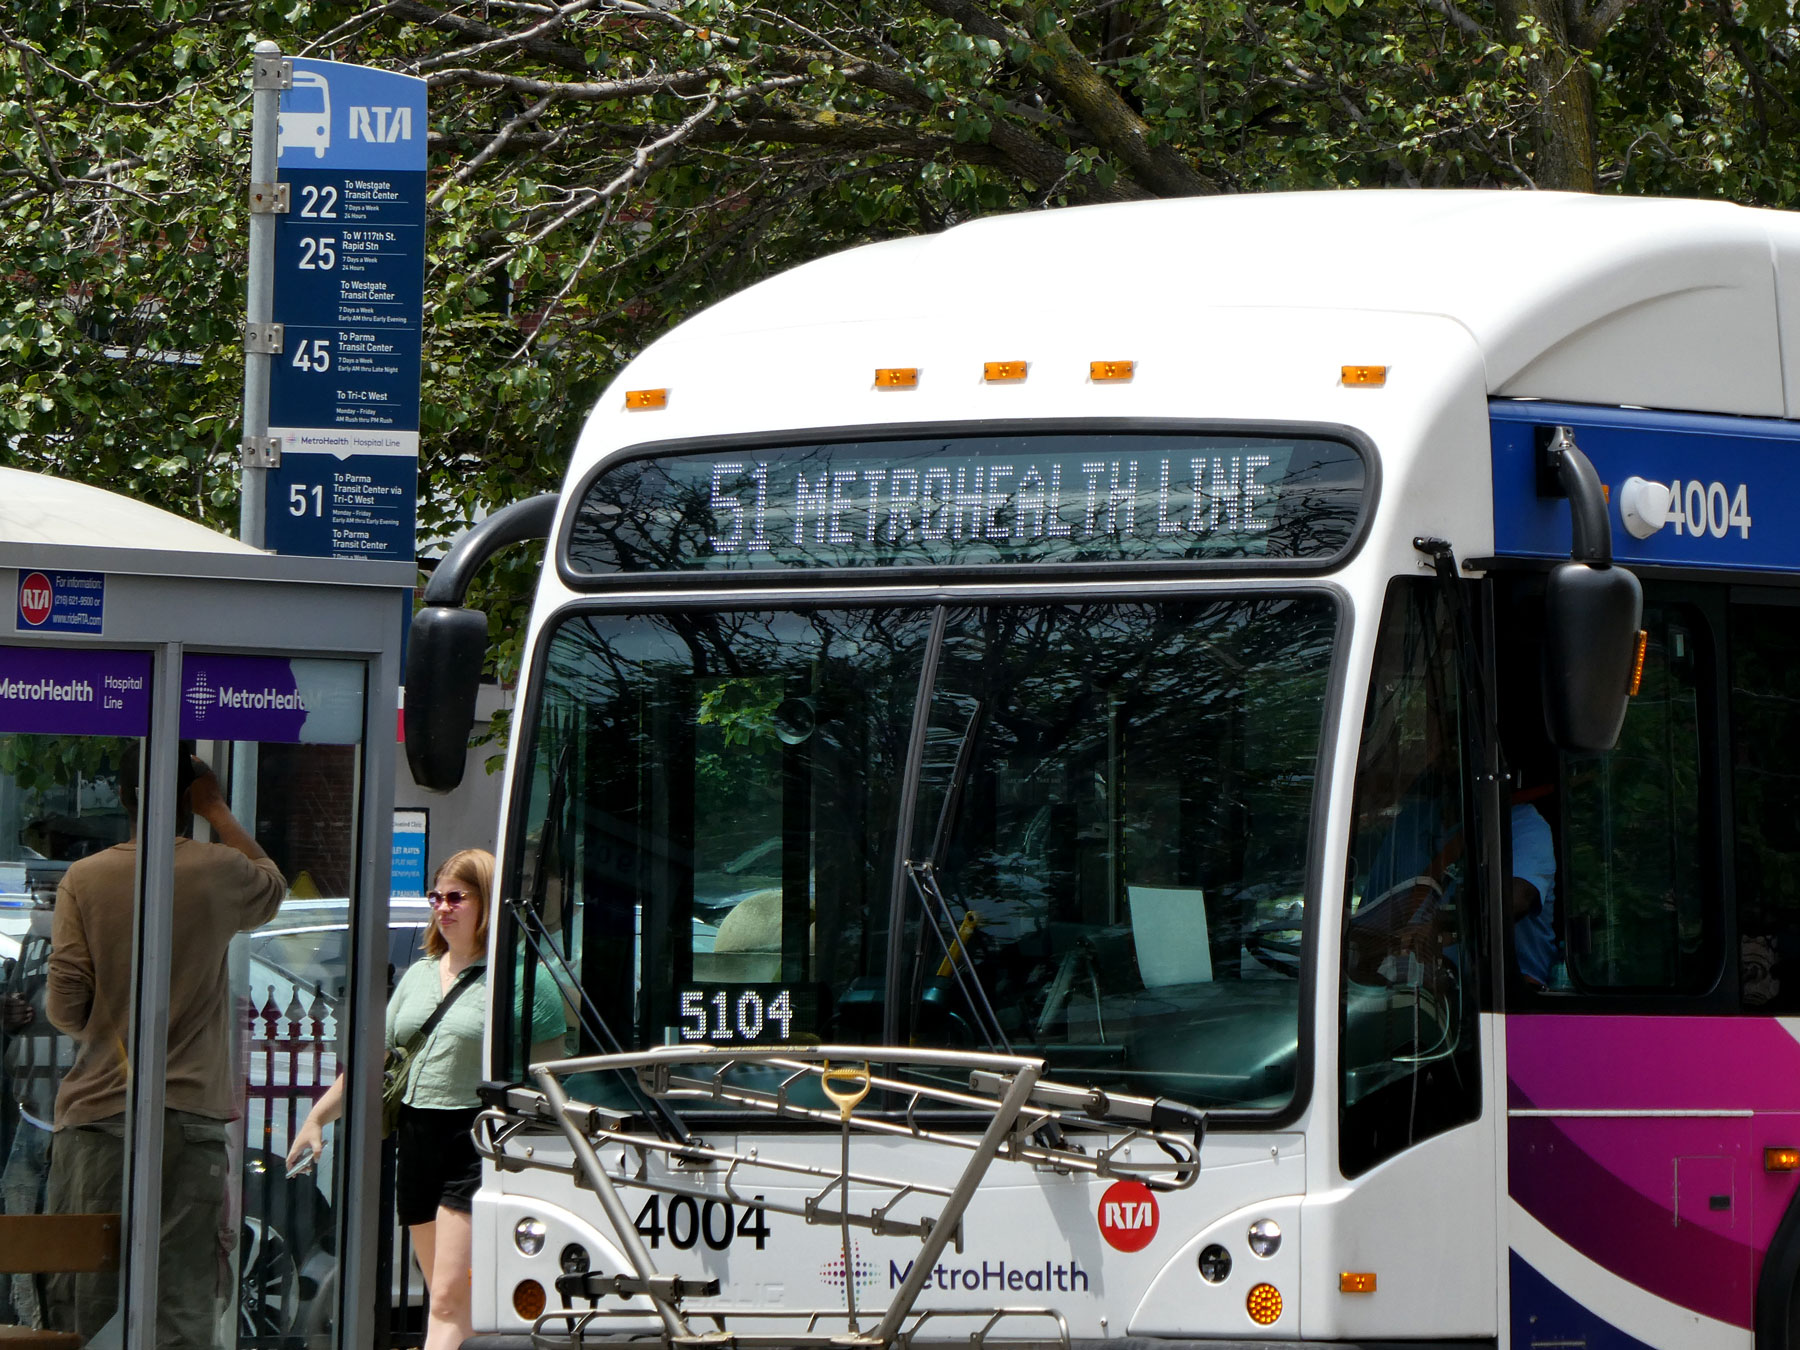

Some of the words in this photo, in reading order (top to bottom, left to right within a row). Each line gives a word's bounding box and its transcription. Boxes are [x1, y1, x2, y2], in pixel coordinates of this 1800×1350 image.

[349, 106, 412, 143] RTA
[344, 180, 354, 189] To
[355, 180, 391, 192] Westgate
[344, 190, 372, 199] Transit
[372, 191, 399, 200] Center
[300, 185, 338, 219] 22
[349, 204, 361, 212] Days
[343, 231, 352, 240] To
[353, 231, 363, 240] W
[363, 232, 385, 241] 117th
[385, 232, 397, 241] St.
[342, 241, 365, 251] Rapid
[365, 242, 379, 251] Stn
[298, 237, 336, 271] 25
[347, 256, 360, 264] Days
[341, 281, 350, 290] To
[351, 281, 387, 292] Westgate
[340, 290, 367, 300] Transit
[368, 291, 395, 301] Center
[386, 316, 407, 324] Evening
[338, 332, 348, 341] To
[349, 332, 375, 342] Parma
[338, 342, 366, 351] Transit
[367, 343, 394, 352] Center
[292, 339, 330, 373] 45
[342, 357, 354, 365] Days
[336, 390, 346, 400] To
[347, 391, 367, 400] Tri-C
[368, 391, 388, 401] West
[359, 408, 376, 416] Friday
[301, 436, 349, 447] MetroHealth
[353, 437, 384, 448] Hospital
[385, 439, 401, 448] Line
[334, 473, 344, 482] To
[345, 473, 371, 483] Parma
[333, 483, 362, 494] Transit
[363, 484, 389, 495] Center
[390, 485, 402, 495] via
[289, 483, 323, 518] 51
[333, 494, 353, 504] Tri-C
[354, 495, 375, 505] West
[709, 463, 771, 551] 51
[794, 460, 1138, 544] METROHEALTH
[1157, 455, 1270, 532] LINE
[332, 509, 352, 517] Monday
[355, 510, 371, 518] Friday
[1664, 480, 1752, 539] 4004
[366, 518, 379, 526] Early
[332, 529, 342, 539] To
[343, 529, 370, 539] Parma
[332, 539, 360, 549] Transit
[360, 540, 389, 550] Center
[56, 576, 66, 587] For
[66, 576, 102, 589] information:
[23, 588, 50, 610] RTA
[55, 595, 68, 606] (216)
[94, 598, 101, 606] or
[52, 612, 102, 626] www.rideRTA.com
[0, 677, 93, 702] MetroHealth
[104, 675, 143, 693] Hospital
[103, 695, 123, 709] Line
[681, 990, 793, 1039] 5104
[1105, 1202, 1152, 1230] RTA
[633, 1193, 771, 1251] 4004
